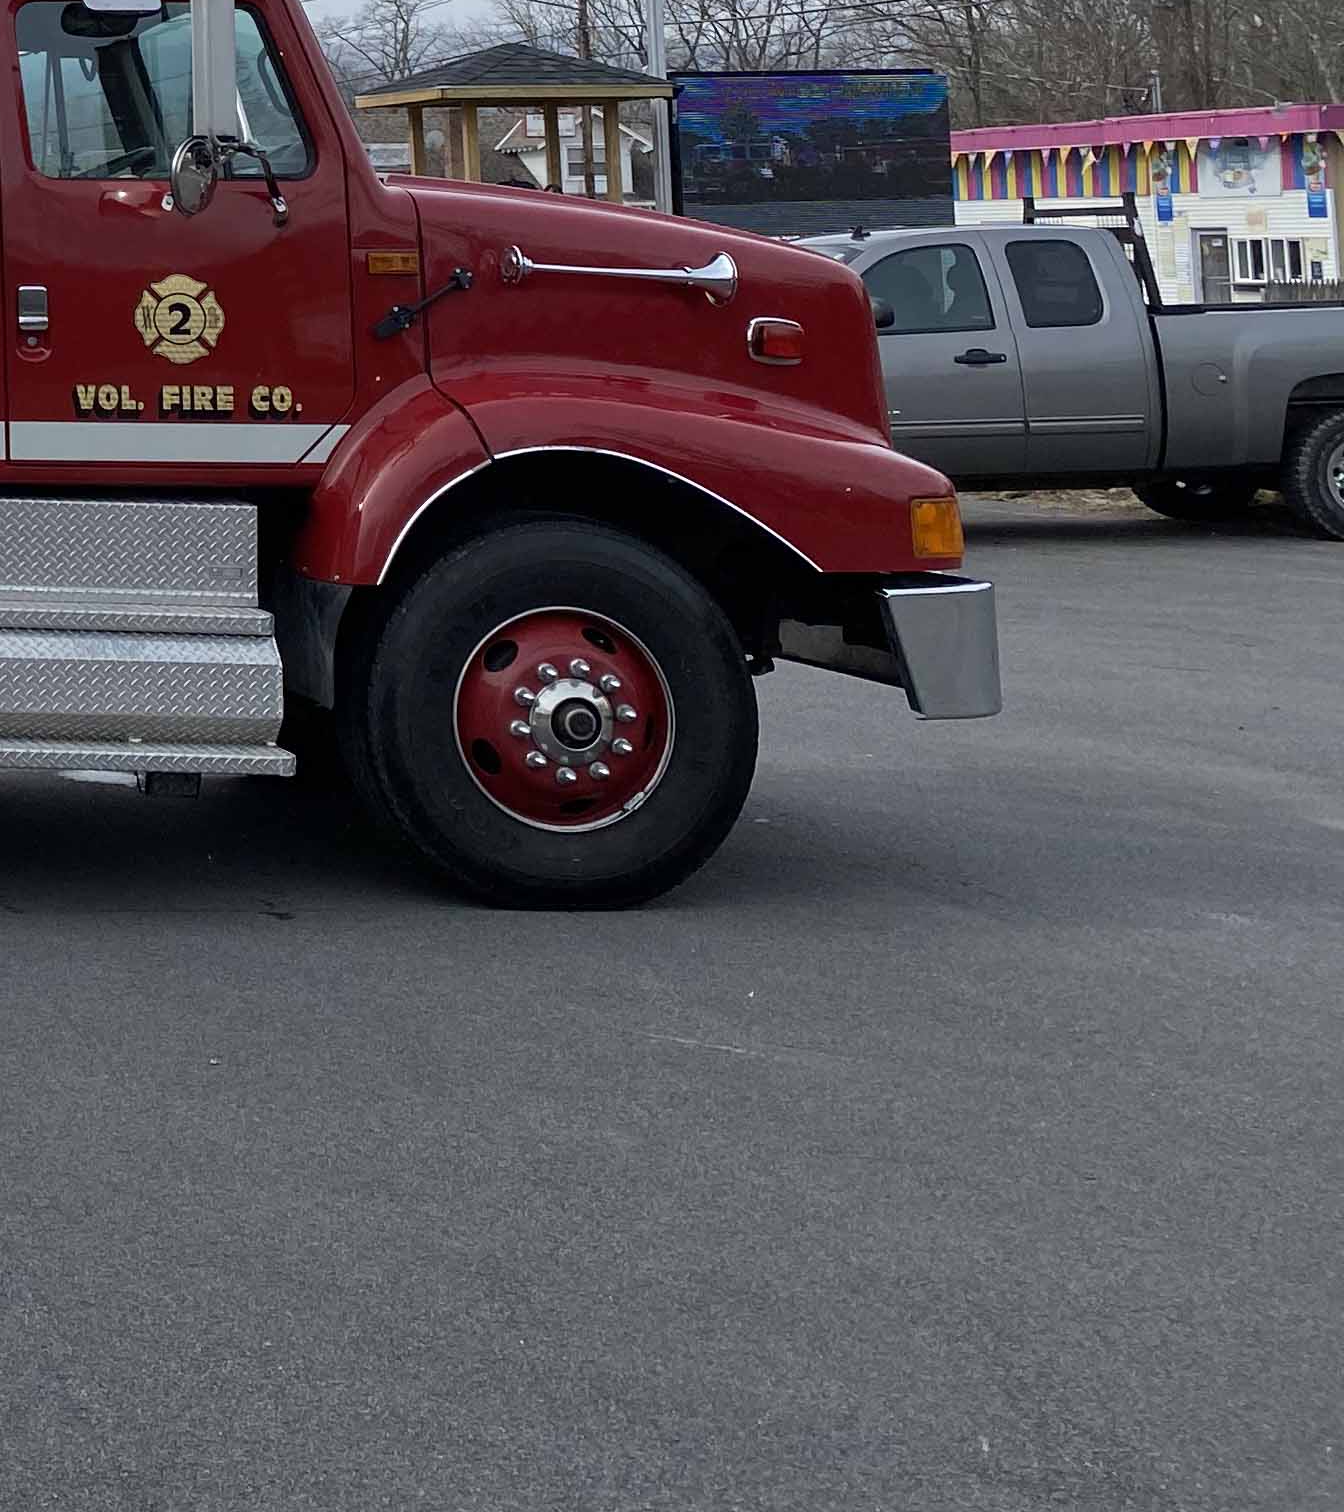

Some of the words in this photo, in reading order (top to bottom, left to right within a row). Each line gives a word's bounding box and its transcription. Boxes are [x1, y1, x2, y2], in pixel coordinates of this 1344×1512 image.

[168, 302, 191, 335] 2
[74, 384, 145, 415] VOL.
[160, 384, 235, 416] FIRE
[250, 384, 303, 416] CO.
